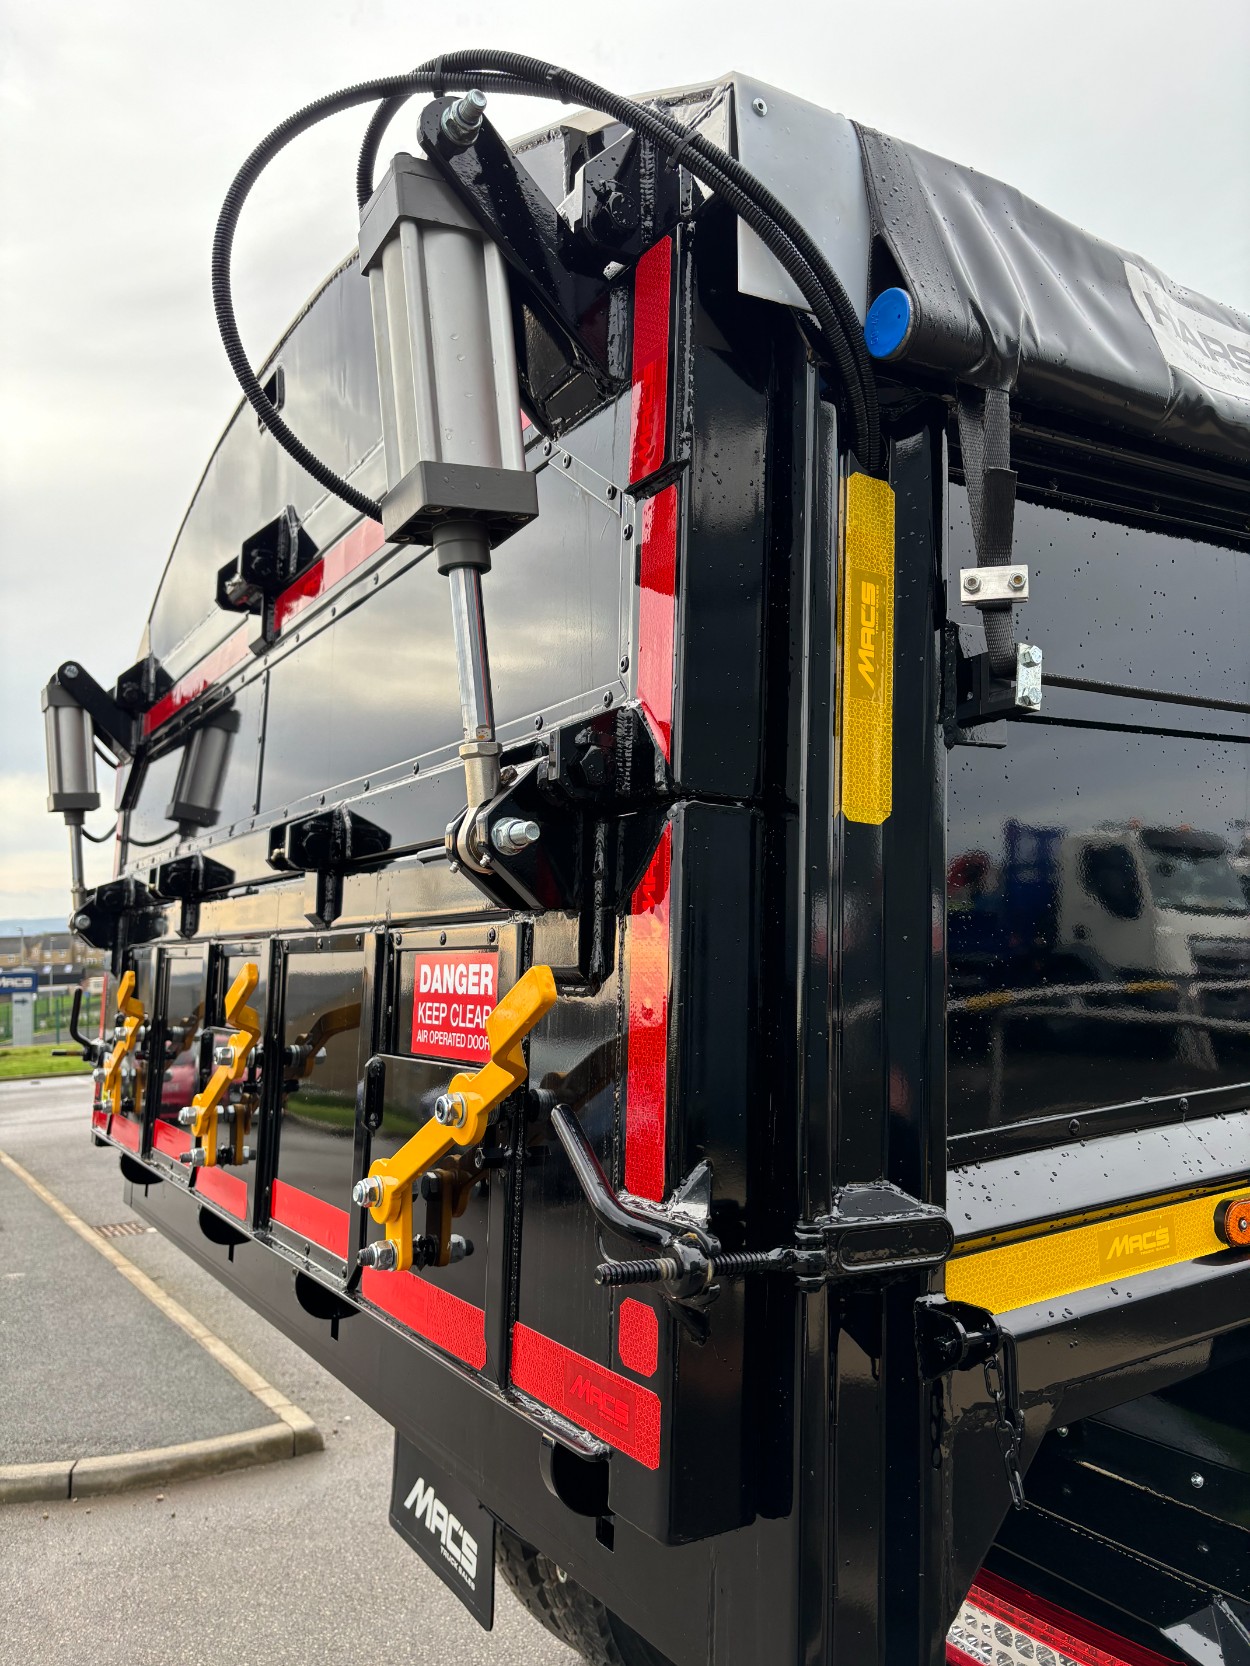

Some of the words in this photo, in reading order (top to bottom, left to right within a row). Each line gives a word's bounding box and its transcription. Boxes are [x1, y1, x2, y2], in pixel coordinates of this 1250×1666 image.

[419, 963, 494, 995] DANGER
[417, 1002, 448, 1025] KEEP
[416, 1029, 429, 1043] AIR
[429, 1031, 466, 1048] OPERATED
[440, 1545, 459, 1571] TRUCK
[458, 1565, 476, 1591] SALES
